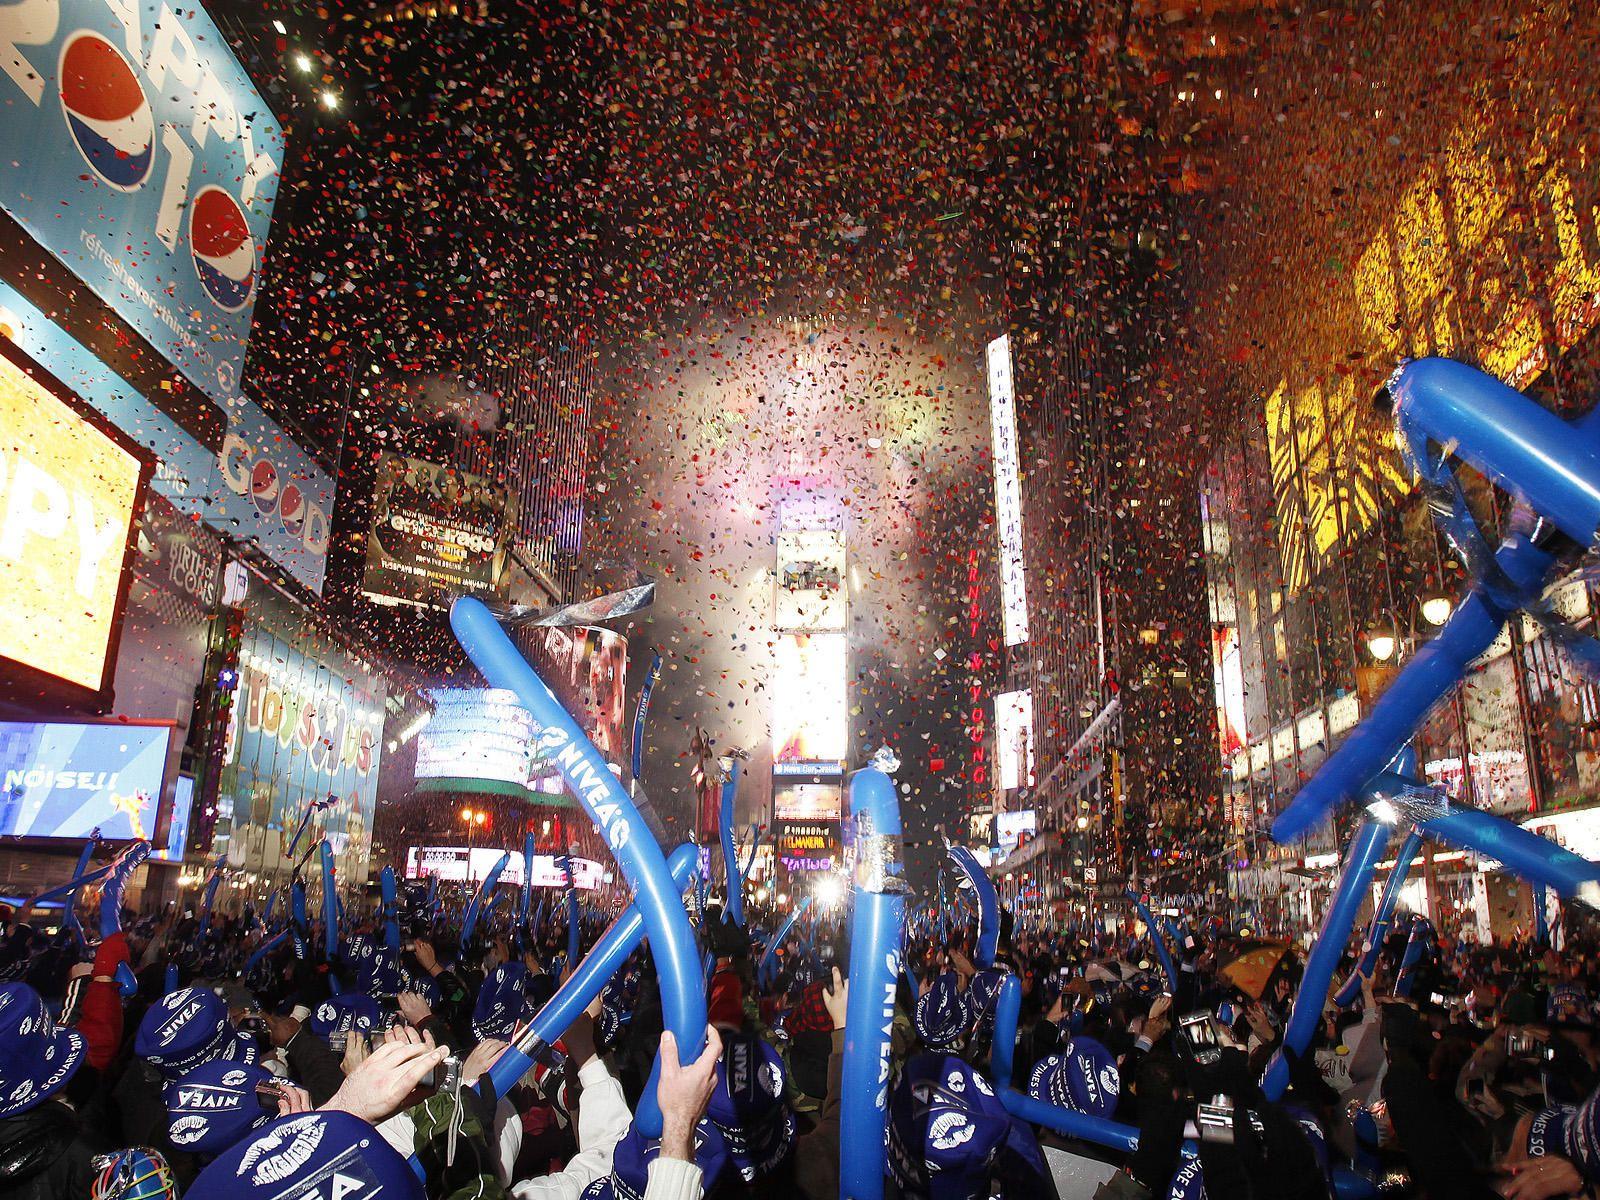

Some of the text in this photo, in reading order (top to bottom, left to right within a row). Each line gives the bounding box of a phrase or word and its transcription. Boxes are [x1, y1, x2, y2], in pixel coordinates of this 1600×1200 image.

[169, 541, 214, 579] BIRTH OF
[169, 563, 214, 605] ICONS
[243, 667, 317, 751] TOYS
[970, 686, 986, 783] YOUNG
[558, 742, 619, 828] NIVEA
[162, 1002, 202, 1038] NIVEA
[878, 983, 897, 1083] NIVEA
[41, 1051, 80, 1091] SQUARE
[68, 1033, 82, 1051] 2010
[180, 1055, 196, 1066] AND
[197, 1049, 205, 1057] BE
[244, 1047, 255, 1065] 2010
[734, 1043, 748, 1093] NIVEA
[1030, 1063, 1048, 1087] TIMES
[178, 1090, 240, 1108] NIVEA
[1056, 1069, 1069, 1109] NIVEA
[1084, 1059, 1097, 1103] NIVEA
[1532, 1109, 1560, 1135] TIMES
